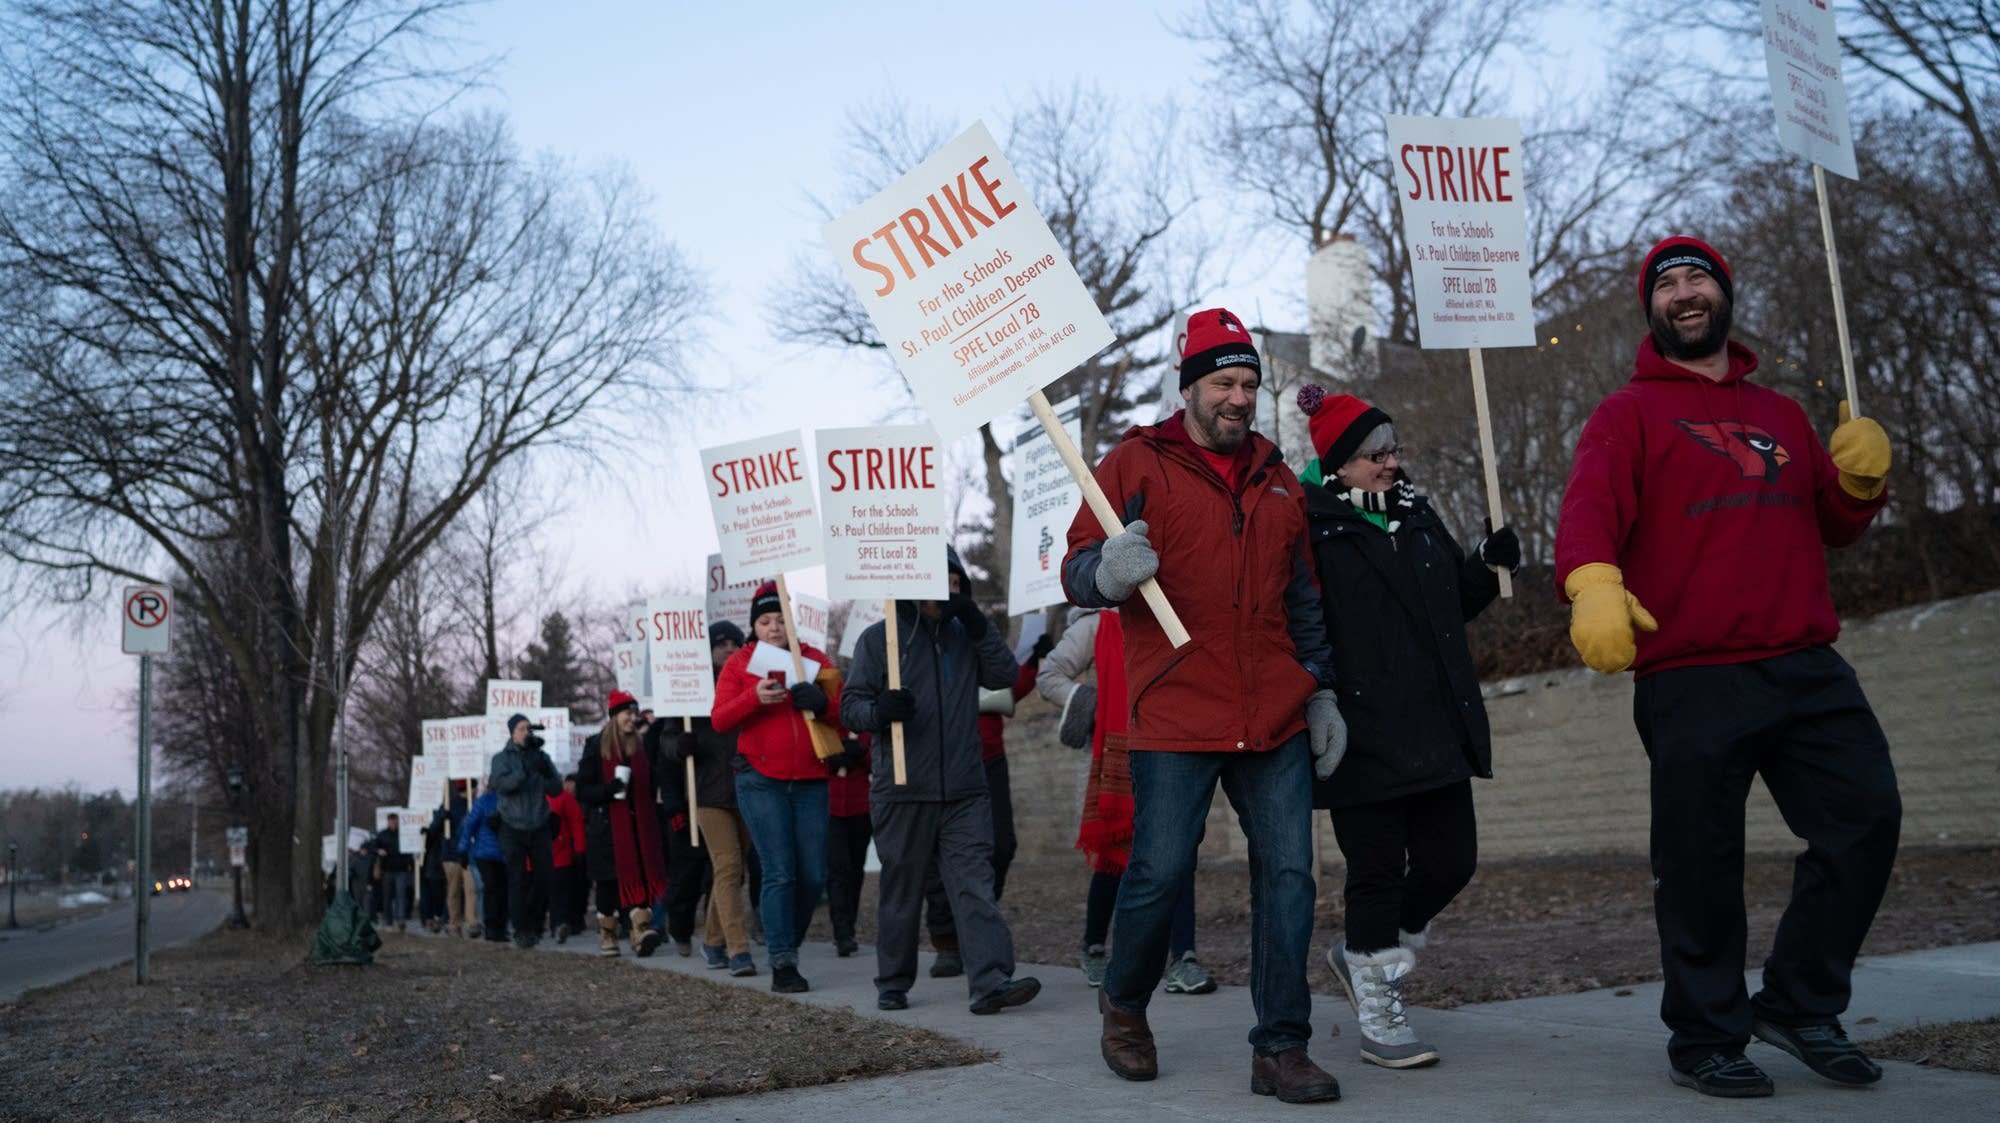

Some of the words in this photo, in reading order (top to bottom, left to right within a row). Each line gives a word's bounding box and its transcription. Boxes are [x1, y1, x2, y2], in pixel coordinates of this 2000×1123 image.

[1401, 143, 1513, 202] STRIKE
[853, 155, 1018, 298] STRIKE
[1431, 220, 1445, 237] For
[1446, 219, 1460, 237] the
[1461, 220, 1494, 239] Schools
[1415, 244, 1428, 261] St.
[1428, 244, 1448, 261] Paul
[1449, 243, 1481, 262] Children
[1483, 246, 1520, 263] Deserve
[918, 296, 942, 317] For
[942, 282, 965, 303] the
[963, 248, 1012, 287] Schools
[1442, 276, 1462, 294] SPFE
[1463, 276, 1483, 294] Local
[1485, 278, 1497, 294] 28
[901, 339, 923, 358] St.
[920, 315, 953, 346] Paul
[952, 287, 1007, 327] Children
[1004, 253, 1056, 293] Deserve
[953, 336, 988, 368] SPFE
[985, 313, 1021, 347] Local
[1019, 302, 1041, 325] 28
[953, 382, 988, 406] Education
[1024, 346, 1039, 363] and
[1038, 340, 1051, 354] the
[1050, 323, 1077, 346] AFL-CIO
[968, 354, 1000, 381] Affiliated
[999, 346, 1015, 362] with
[711, 447, 803, 497] STRIKE
[827, 446, 936, 492] STRIKE
[736, 505, 749, 515] For
[751, 502, 763, 512] the
[764, 496, 792, 509] Schools
[852, 505, 866, 518] For
[869, 504, 883, 517] the
[886, 504, 918, 517] Schools
[1026, 491, 1069, 519] DESERVE
[733, 518, 750, 531] Paul
[751, 514, 783, 528] Children
[783, 508, 812, 520] Deserve
[830, 525, 842, 537] St.
[845, 523, 865, 536] Paul
[868, 522, 904, 536] Children
[907, 522, 940, 535] Deserve
[766, 530, 785, 543] Local
[857, 547, 878, 559] SPFE
[881, 546, 903, 559] Local
[906, 546, 918, 559] 28
[653, 609, 706, 641] STRIKE
[491, 688, 538, 708] STRIKE
[451, 723, 480, 742] STRIKE
